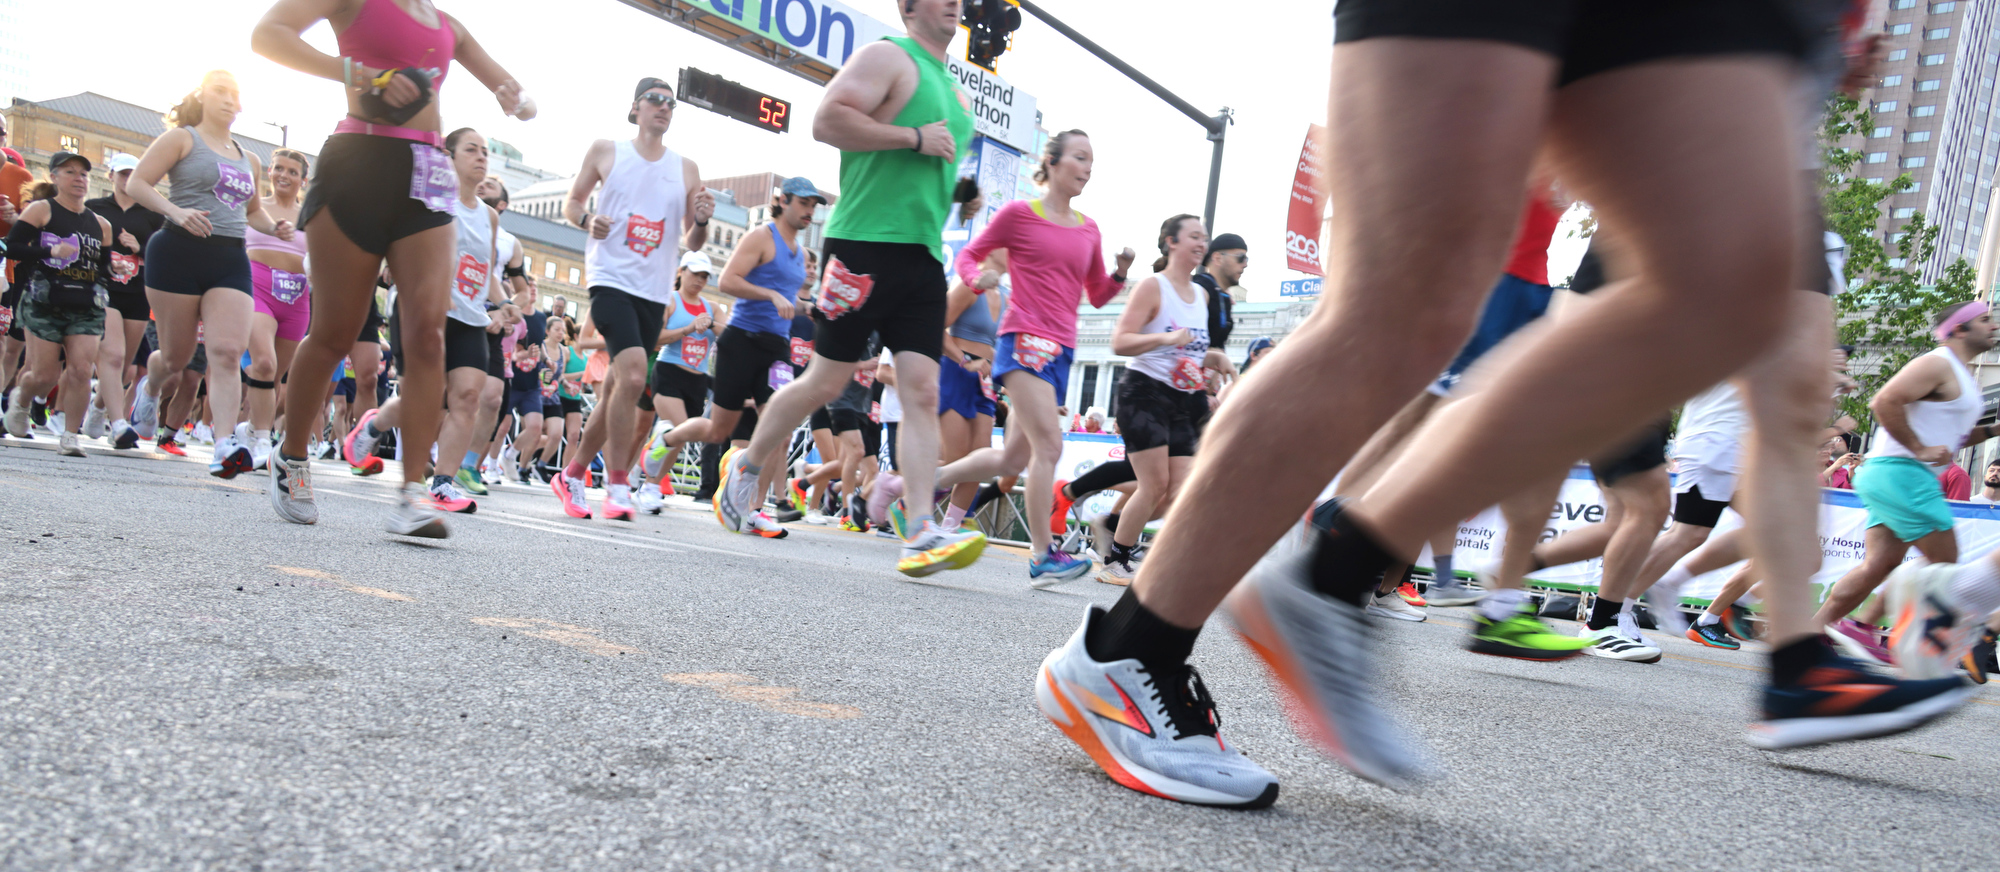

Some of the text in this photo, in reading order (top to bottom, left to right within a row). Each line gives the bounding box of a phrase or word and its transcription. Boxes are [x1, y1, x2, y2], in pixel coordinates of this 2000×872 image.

[708, 0, 855, 66] on
[758, 96, 787, 128] 52
[973, 96, 1010, 129] thon
[224, 175, 252, 195] 2443
[1292, 190, 1302, 201] May
[631, 225, 660, 241] 4925
[1287, 230, 1319, 259] 200
[278, 279, 301, 291] 1824
[1282, 282, 1299, 294] St.
[685, 344, 706, 354] 4456
[793, 345, 812, 355] 6256
[1549, 501, 1605, 523] eve
[1454, 537, 1490, 551] pitals
[1537, 527, 1568, 545] a
[1832, 536, 1866, 550] Hospi
